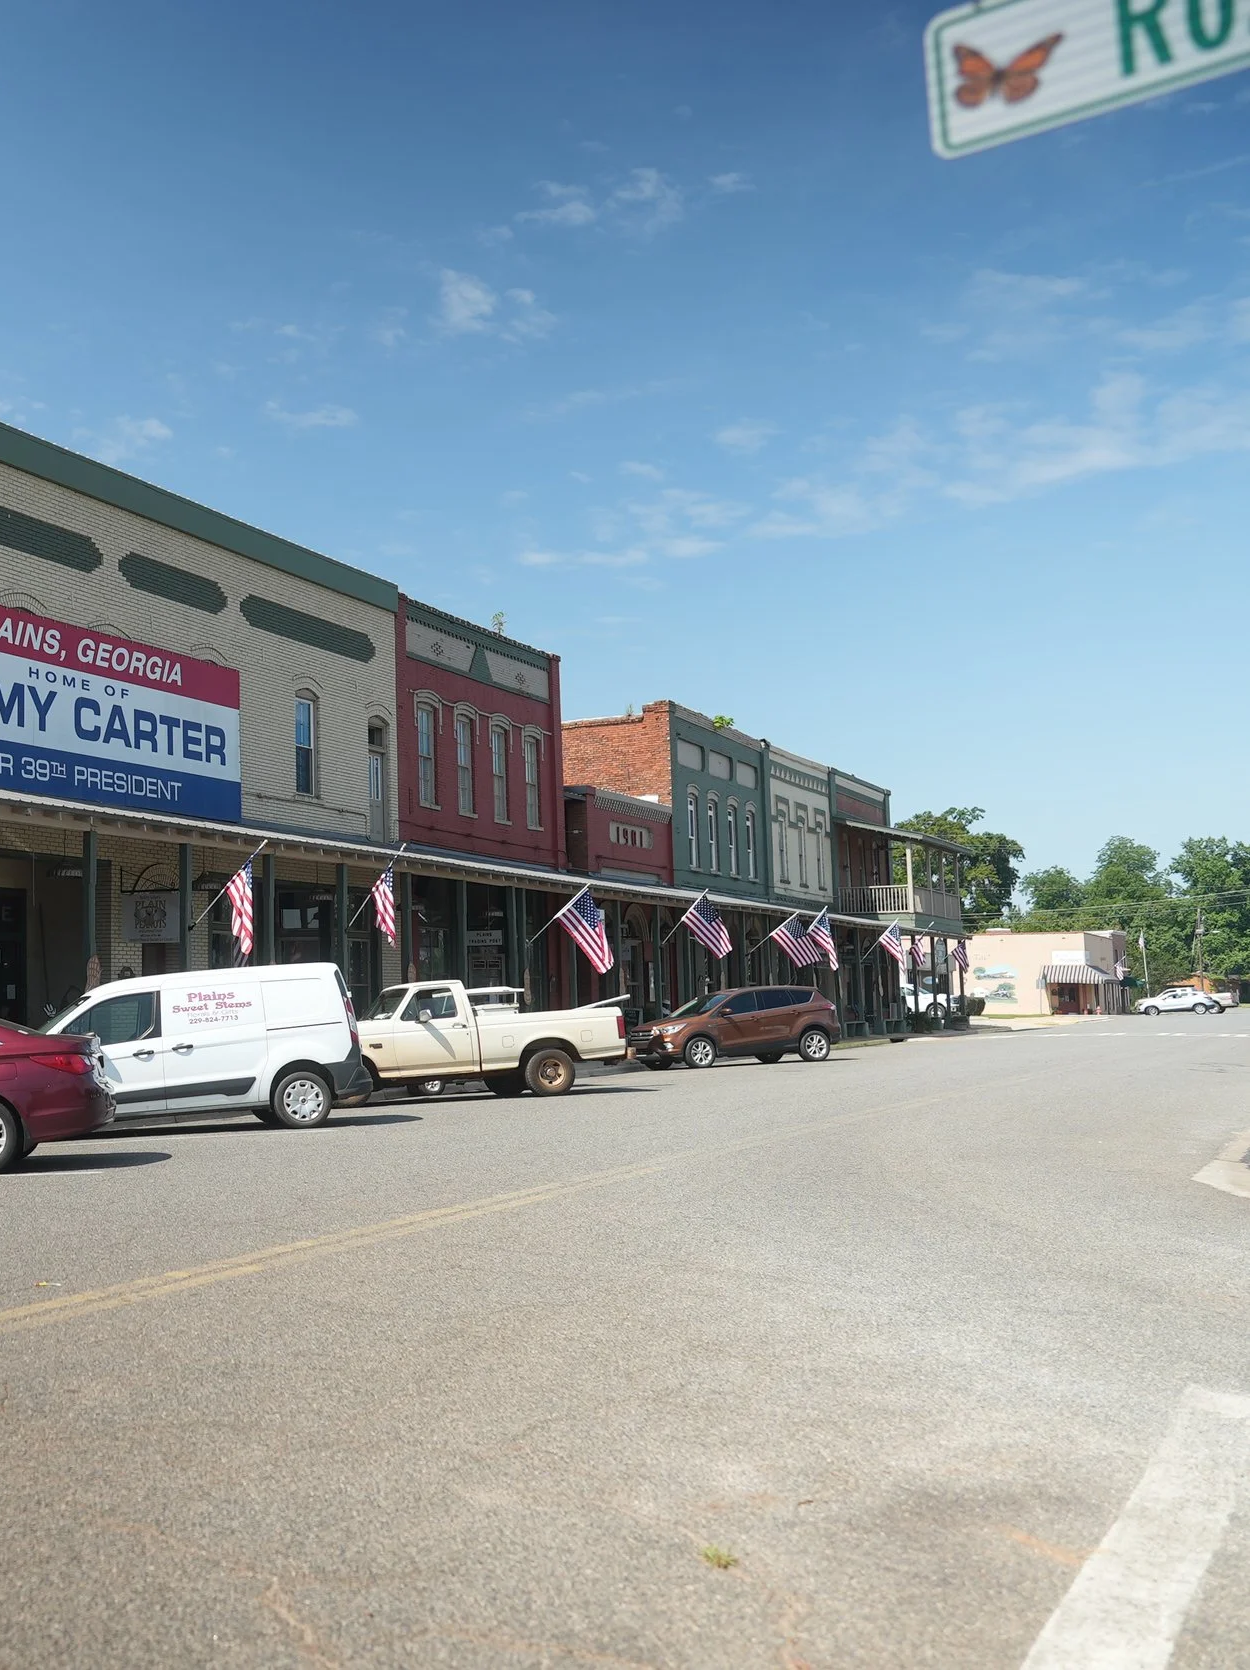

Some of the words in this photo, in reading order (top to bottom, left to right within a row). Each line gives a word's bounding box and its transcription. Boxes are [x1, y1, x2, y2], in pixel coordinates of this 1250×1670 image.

[77, 638, 182, 686] GEORGIA
[28, 666, 91, 691] HOME
[104, 684, 130, 699] OF
[74, 697, 226, 766] CARTER
[21, 759, 67, 781] 39TH
[74, 766, 182, 801] PRESIDENT
[616, 826, 643, 848] 1901
[134, 900, 166, 910] PLAIN
[172, 1003, 208, 1013] Sweet
[215, 1001, 252, 1009] Stems
[187, 991, 235, 1003] Plains
